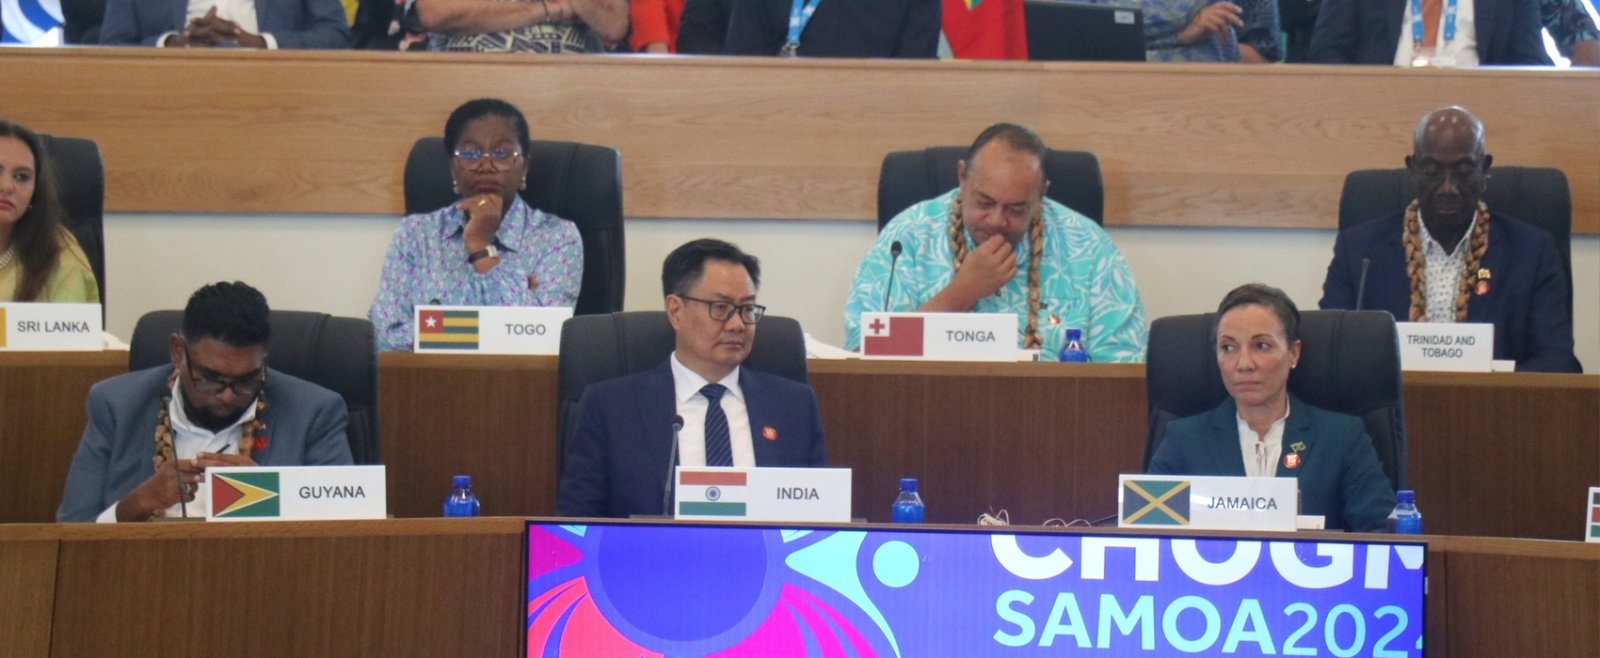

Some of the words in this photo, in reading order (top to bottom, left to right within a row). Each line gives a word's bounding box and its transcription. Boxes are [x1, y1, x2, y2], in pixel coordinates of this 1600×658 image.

[17, 320, 41, 333] SRI
[44, 321, 90, 333] LANKA
[504, 323, 547, 336] TOGO
[945, 330, 996, 343] TONGA
[1407, 334, 1453, 346] TRINIDAD
[1454, 335, 1476, 347] AND
[1421, 347, 1463, 359] TOBAGO
[298, 485, 366, 500] GUYANA
[776, 487, 820, 501] INDIA
[1207, 495, 1278, 511] JAMAICA
[992, 589, 1423, 658] SAMOA202
